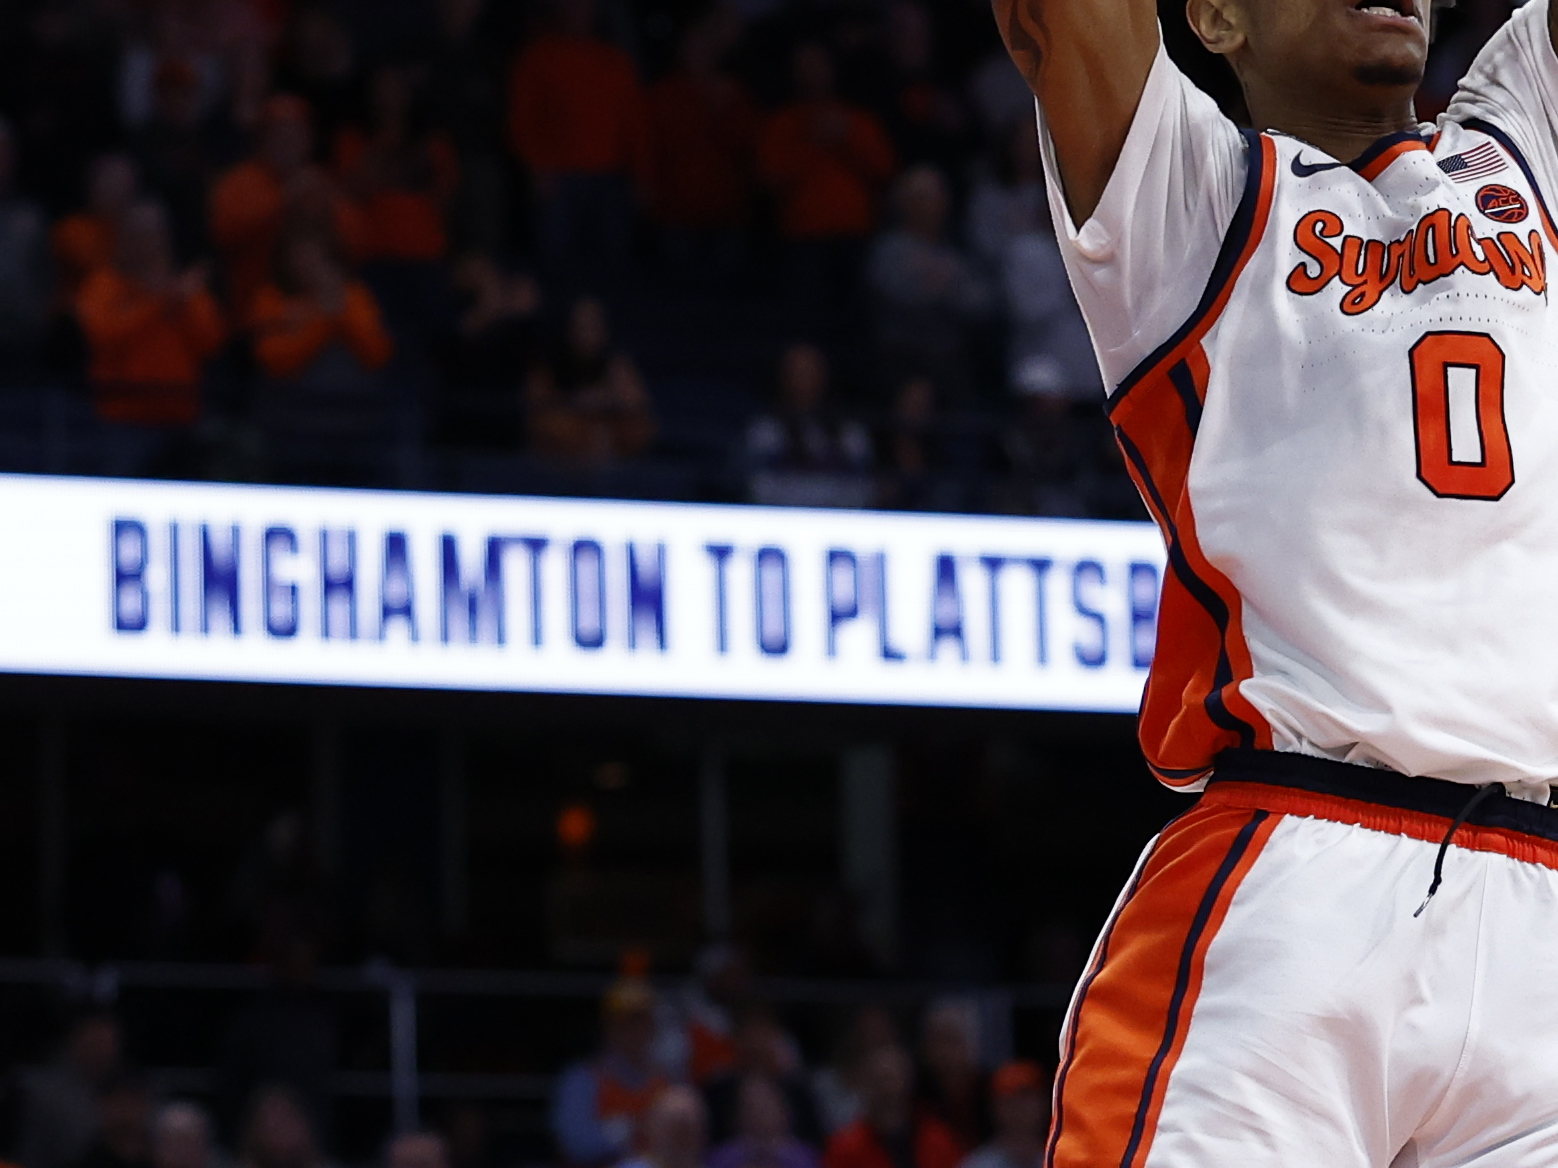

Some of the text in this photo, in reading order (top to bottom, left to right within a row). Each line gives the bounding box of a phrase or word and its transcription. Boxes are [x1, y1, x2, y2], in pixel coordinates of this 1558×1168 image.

[1408, 331, 1515, 501] 0
[111, 518, 668, 652] BINGHAMTON
[706, 544, 790, 656] TO
[827, 548, 1158, 669] PLATTSB
